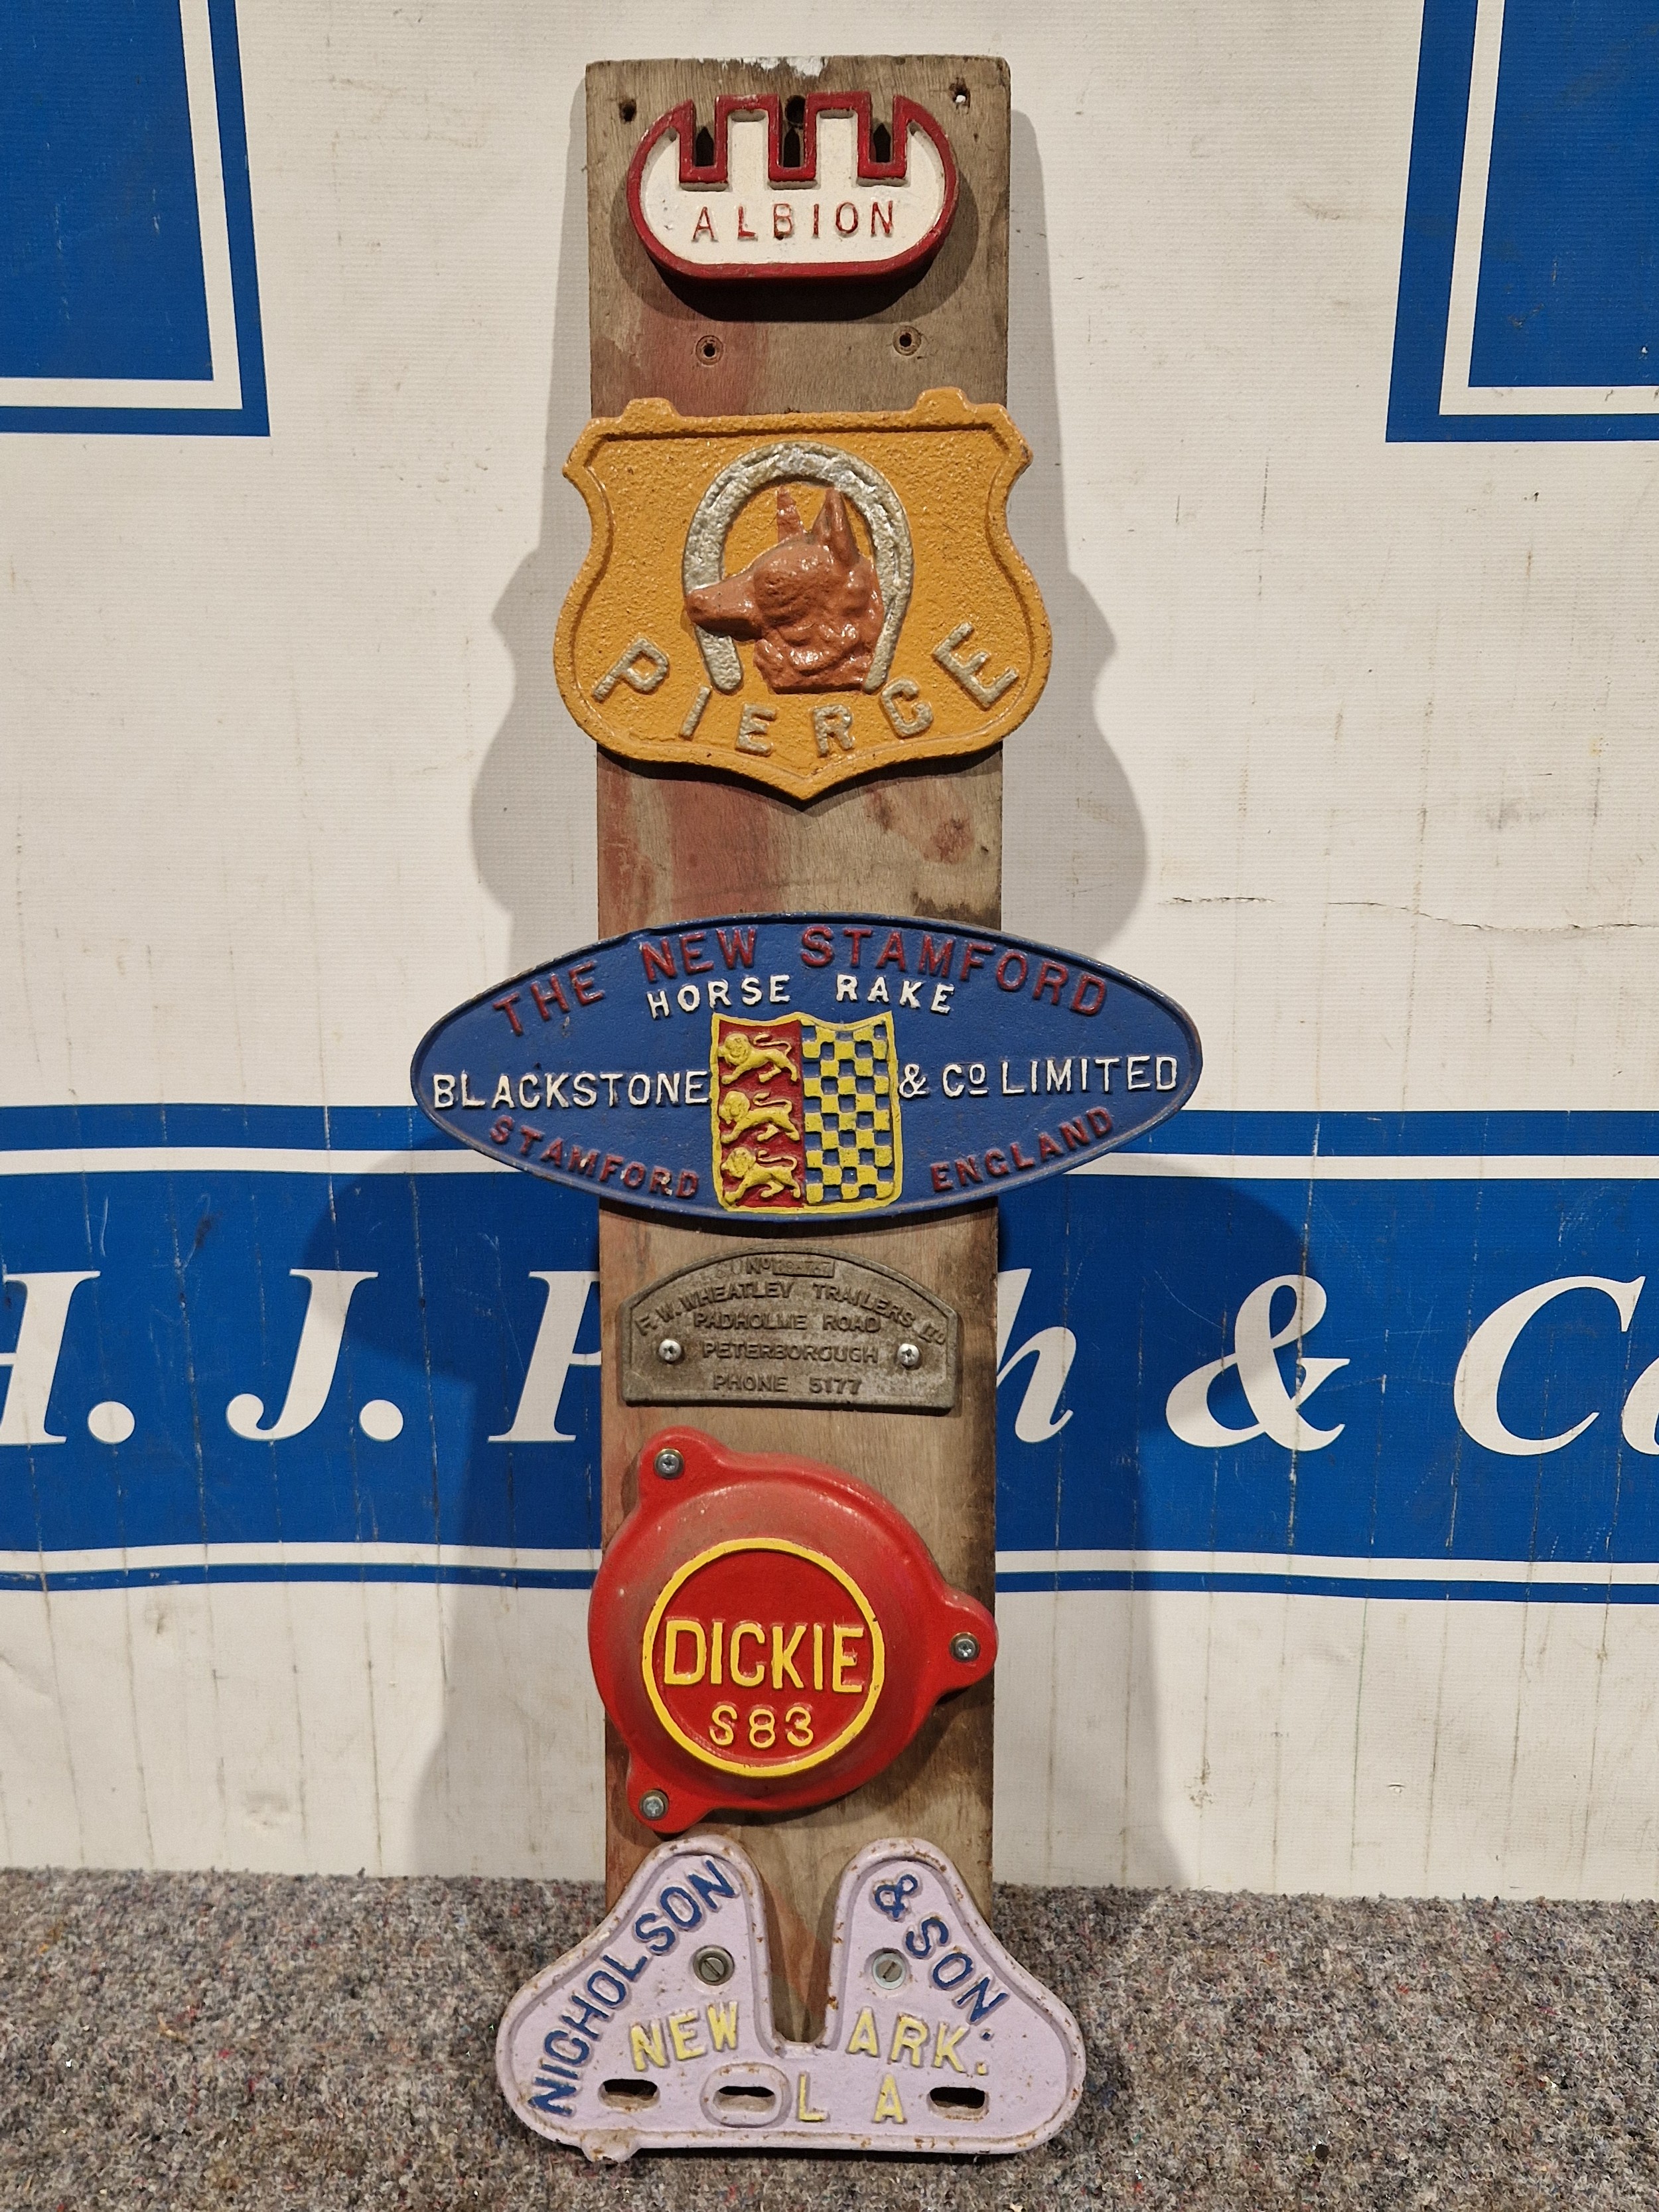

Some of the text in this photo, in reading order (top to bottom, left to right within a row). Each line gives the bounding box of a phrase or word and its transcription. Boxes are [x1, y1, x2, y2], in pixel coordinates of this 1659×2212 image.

[692, 200, 894, 241] ALBION
[593, 622, 1019, 757] PIERCE
[493, 925, 1107, 1035] THE NEW STAMFORD
[647, 974, 955, 1019] HORSE RAKE
[433, 1070, 711, 1109] BLACKSTONE
[898, 1063, 927, 1098] &
[1002, 1055, 1178, 1096] LIMITED
[489, 1115, 699, 1199] STAMFORD
[930, 1107, 1114, 1193] ENGLAND
[693, 1311, 881, 1333] PADHOLME ROAD
[702, 1340, 879, 1364] PETERBOROUGH
[226, 1268, 403, 1441] J.
[1165, 1274, 1350, 1452] &
[713, 1374, 861, 1394] PHONE 5177
[664, 1618, 865, 1693] DICKIE
[709, 1704, 814, 1749] S83
[528, 1859, 737, 2117] NICHOLSON
[874, 1874, 919, 1919] &
[629, 2000, 738, 2072] NEW
[798, 2073, 906, 2123] L A
